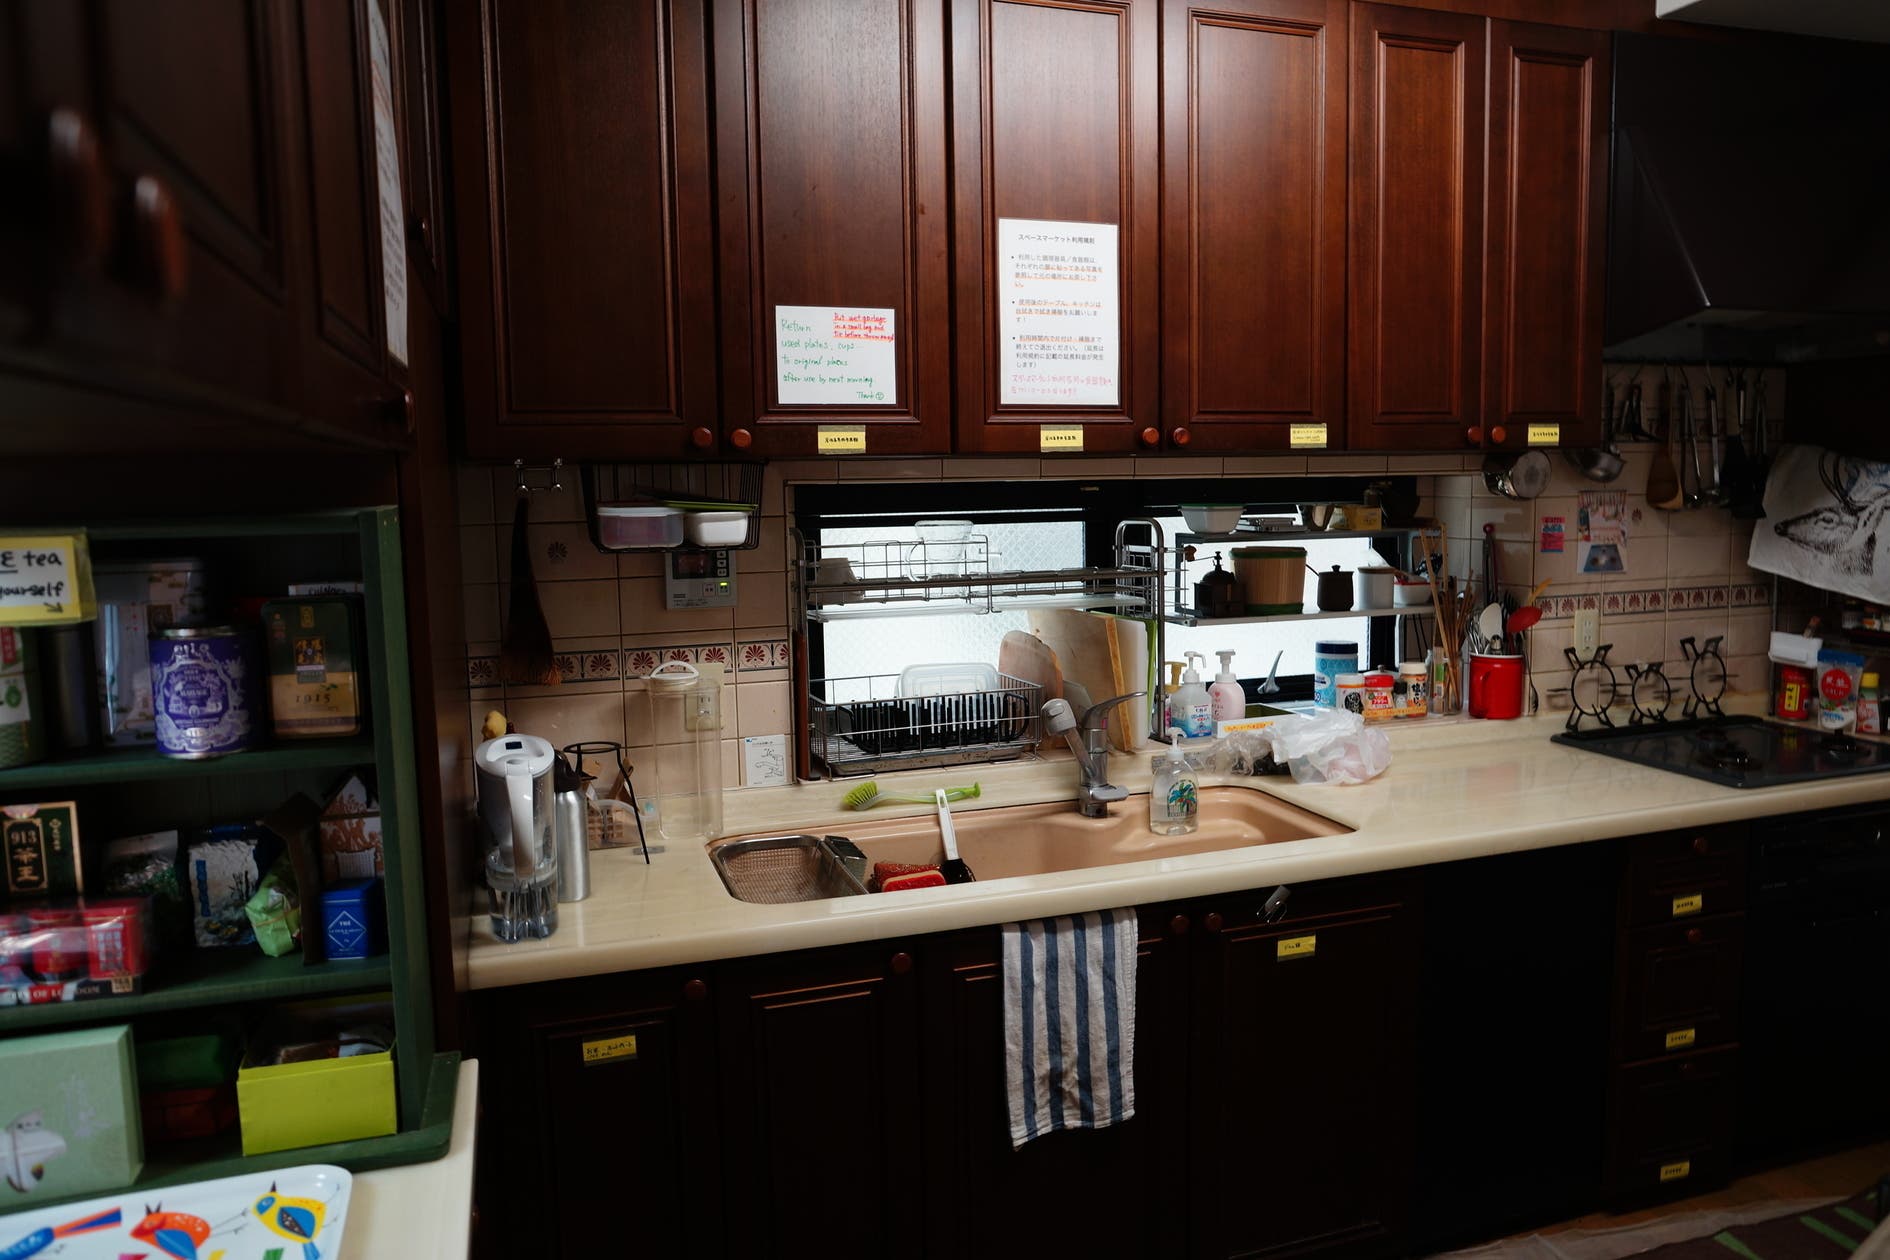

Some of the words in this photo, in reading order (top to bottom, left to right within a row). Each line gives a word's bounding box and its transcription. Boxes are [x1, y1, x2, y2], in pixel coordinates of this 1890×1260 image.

[23, 550, 62, 568] tea
[296, 694, 331, 704] 1915
[11, 830, 36, 845] 913
